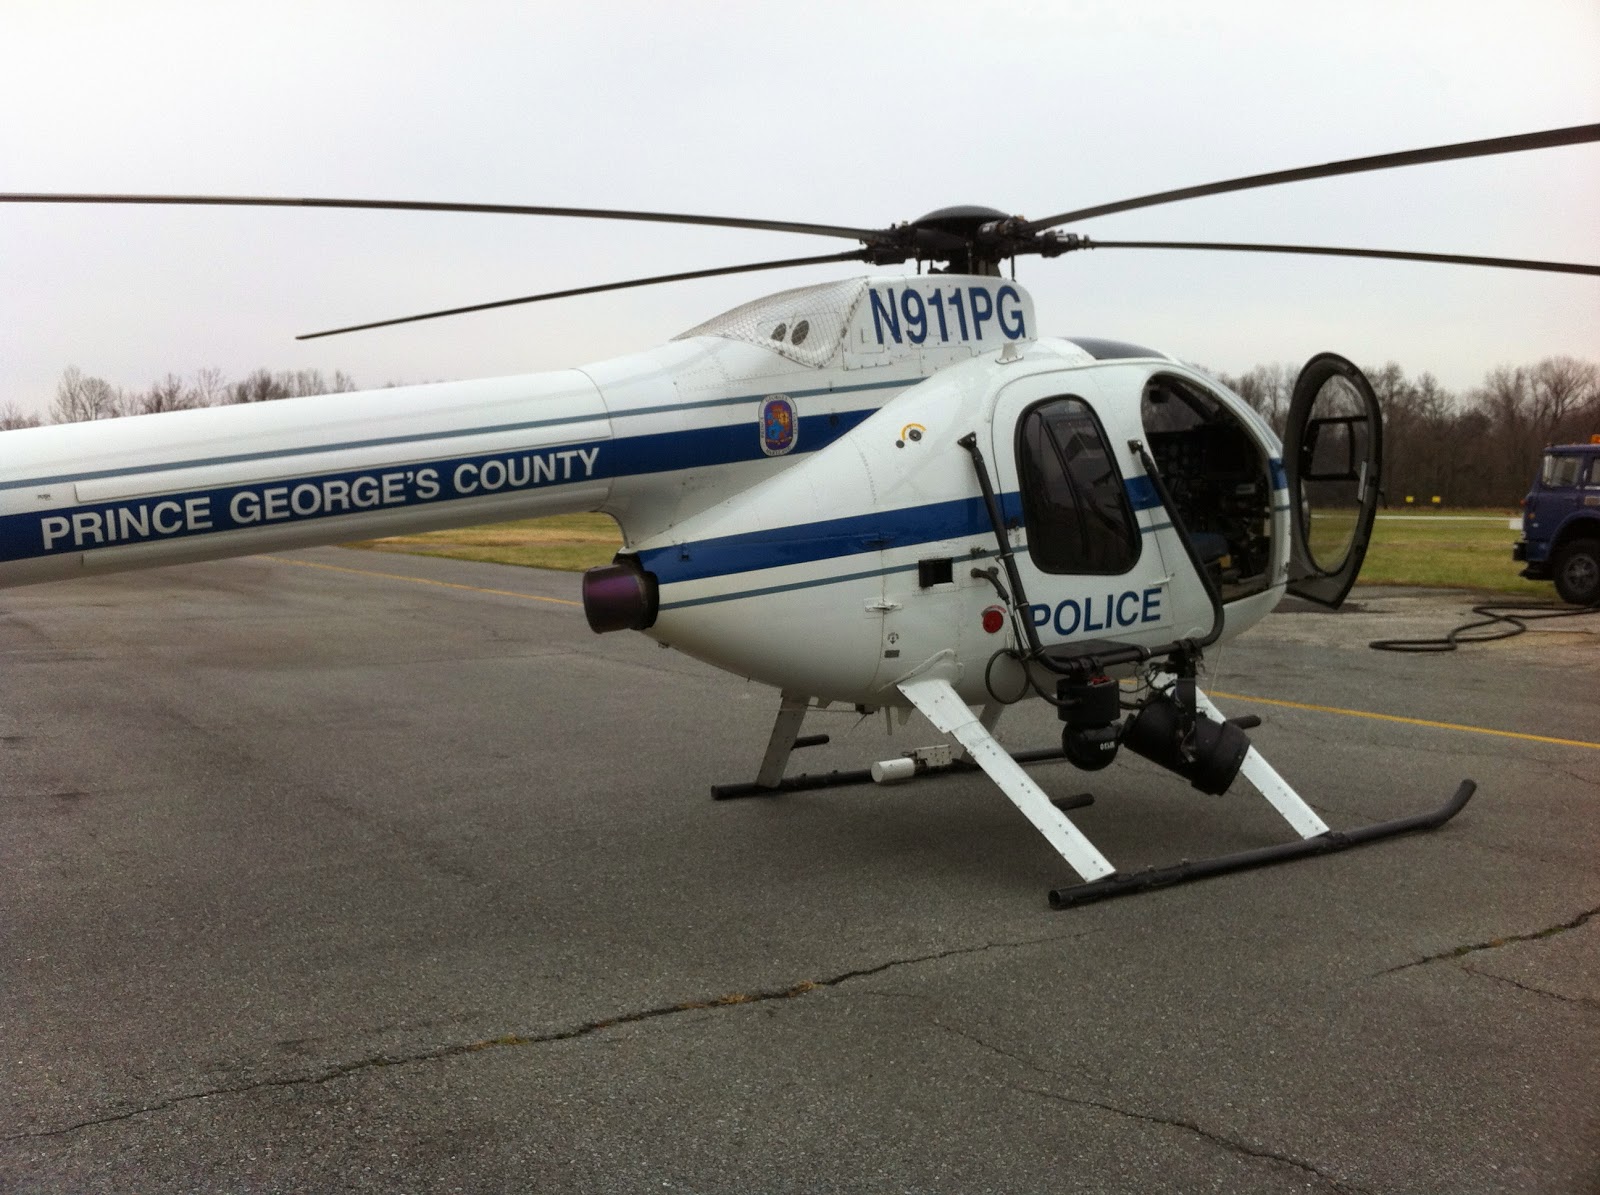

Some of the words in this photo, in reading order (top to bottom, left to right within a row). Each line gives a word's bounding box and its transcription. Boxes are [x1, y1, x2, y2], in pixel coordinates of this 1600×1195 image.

[869, 285, 1026, 344] N911PG
[41, 498, 213, 550] PRINCE
[230, 468, 440, 524] GEORGE'S
[453, 447, 600, 494] COUNTY
[1029, 587, 1162, 636] POLICE
